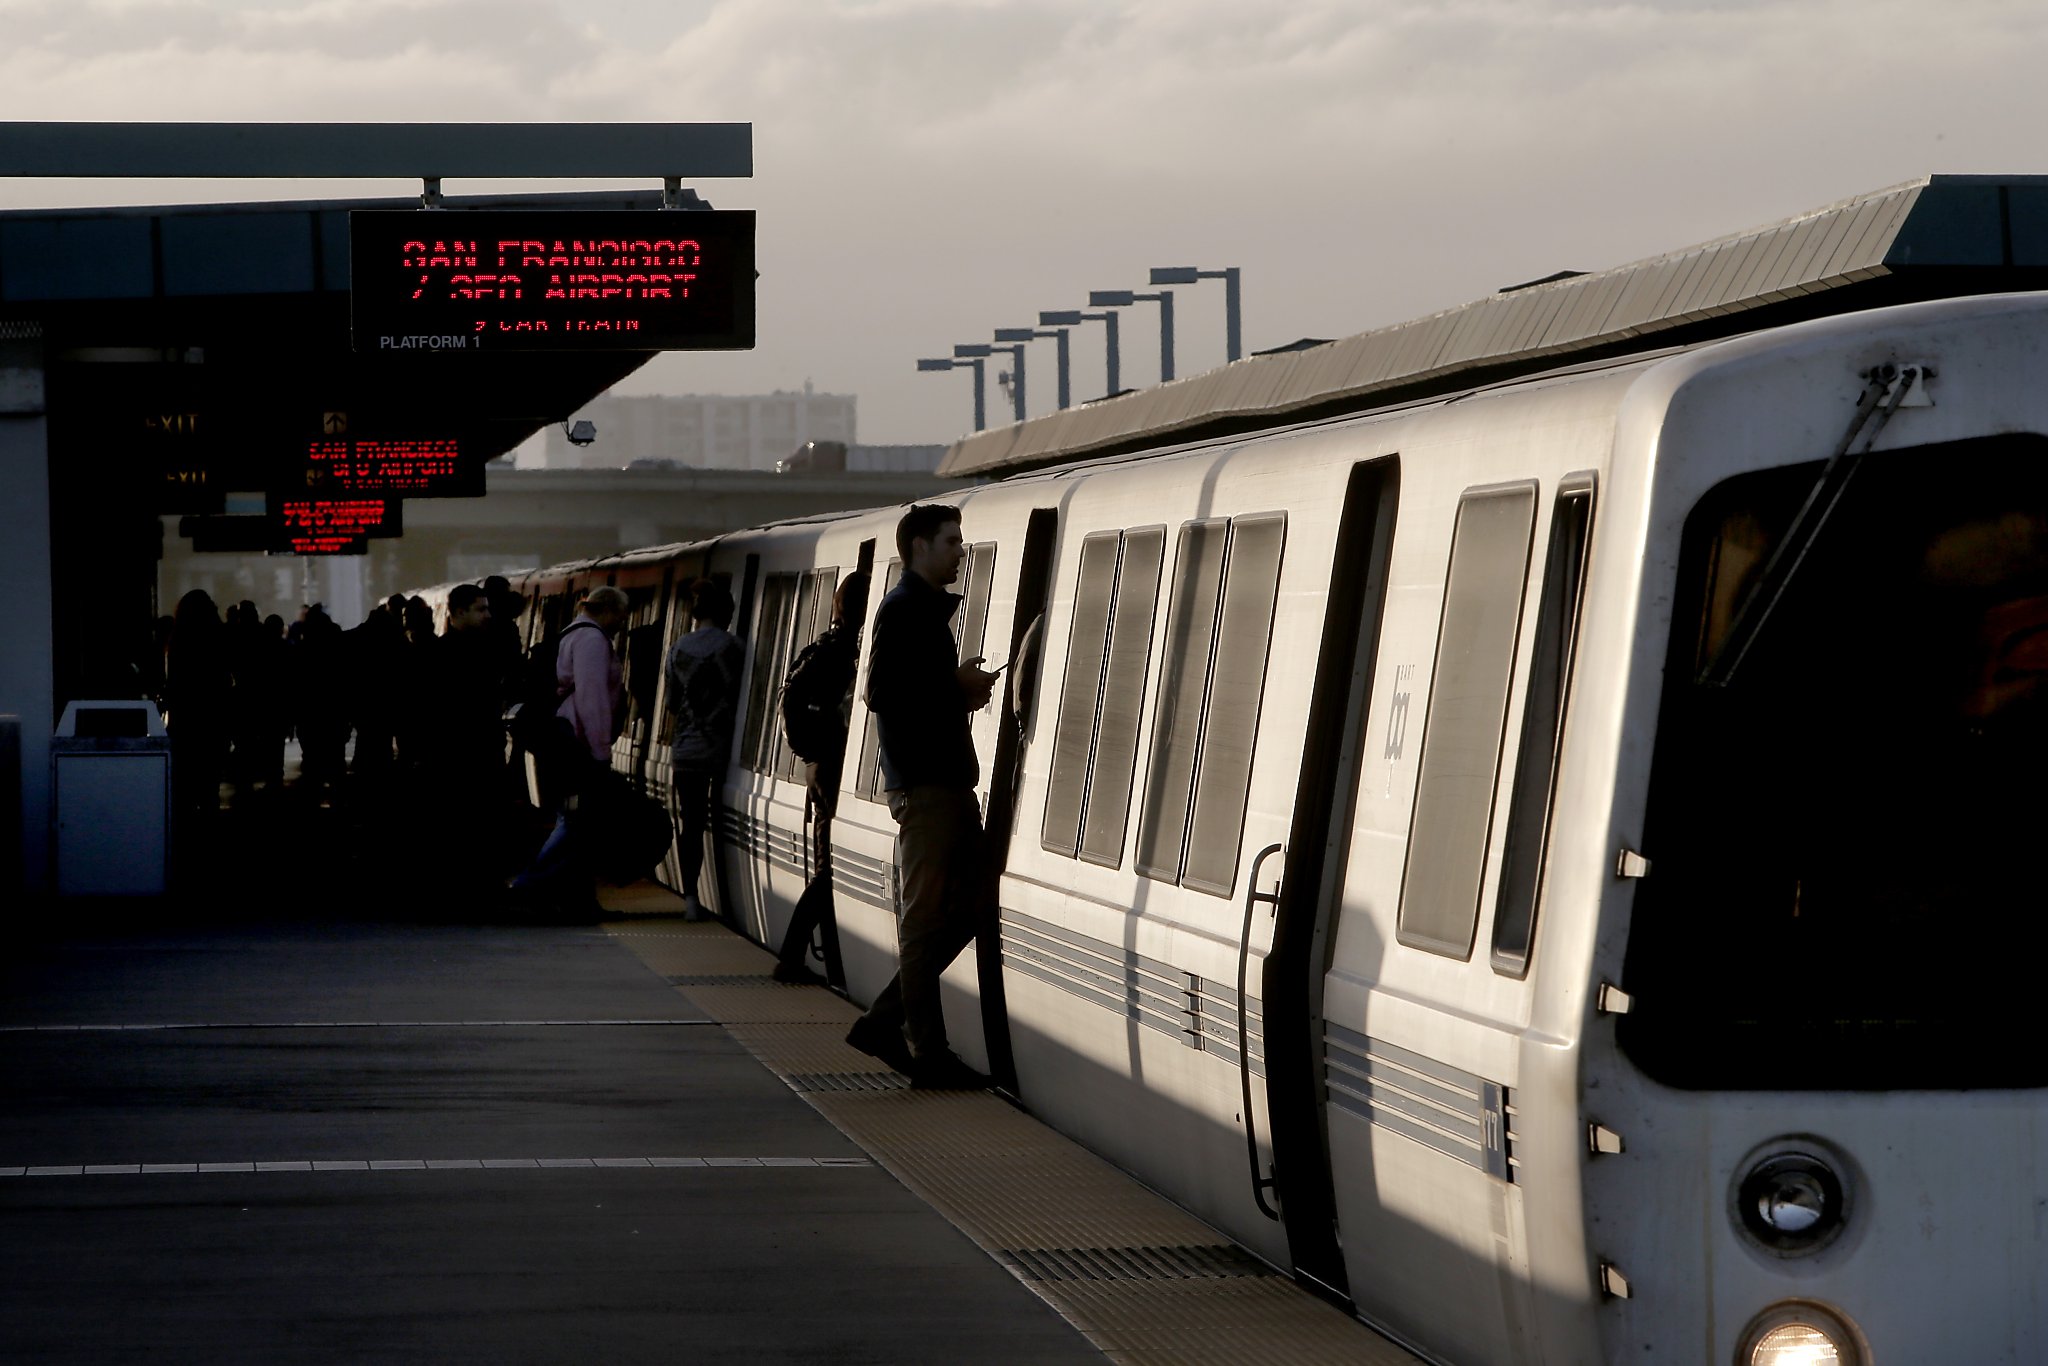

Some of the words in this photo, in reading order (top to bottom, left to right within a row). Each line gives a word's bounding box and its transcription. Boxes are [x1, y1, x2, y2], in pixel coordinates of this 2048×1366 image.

[403, 240, 477, 267] SAN
[498, 239, 701, 267] FRANCISCO
[450, 273, 522, 299] SFO
[545, 273, 697, 299] AIRPORT
[499, 318, 549, 332] CAR
[565, 318, 640, 332] TRAIN
[380, 335, 467, 349] PLATFORM
[472, 335, 480, 348] 1
[308, 441, 348, 460] SAN
[355, 439, 459, 459] FRANCISCO
